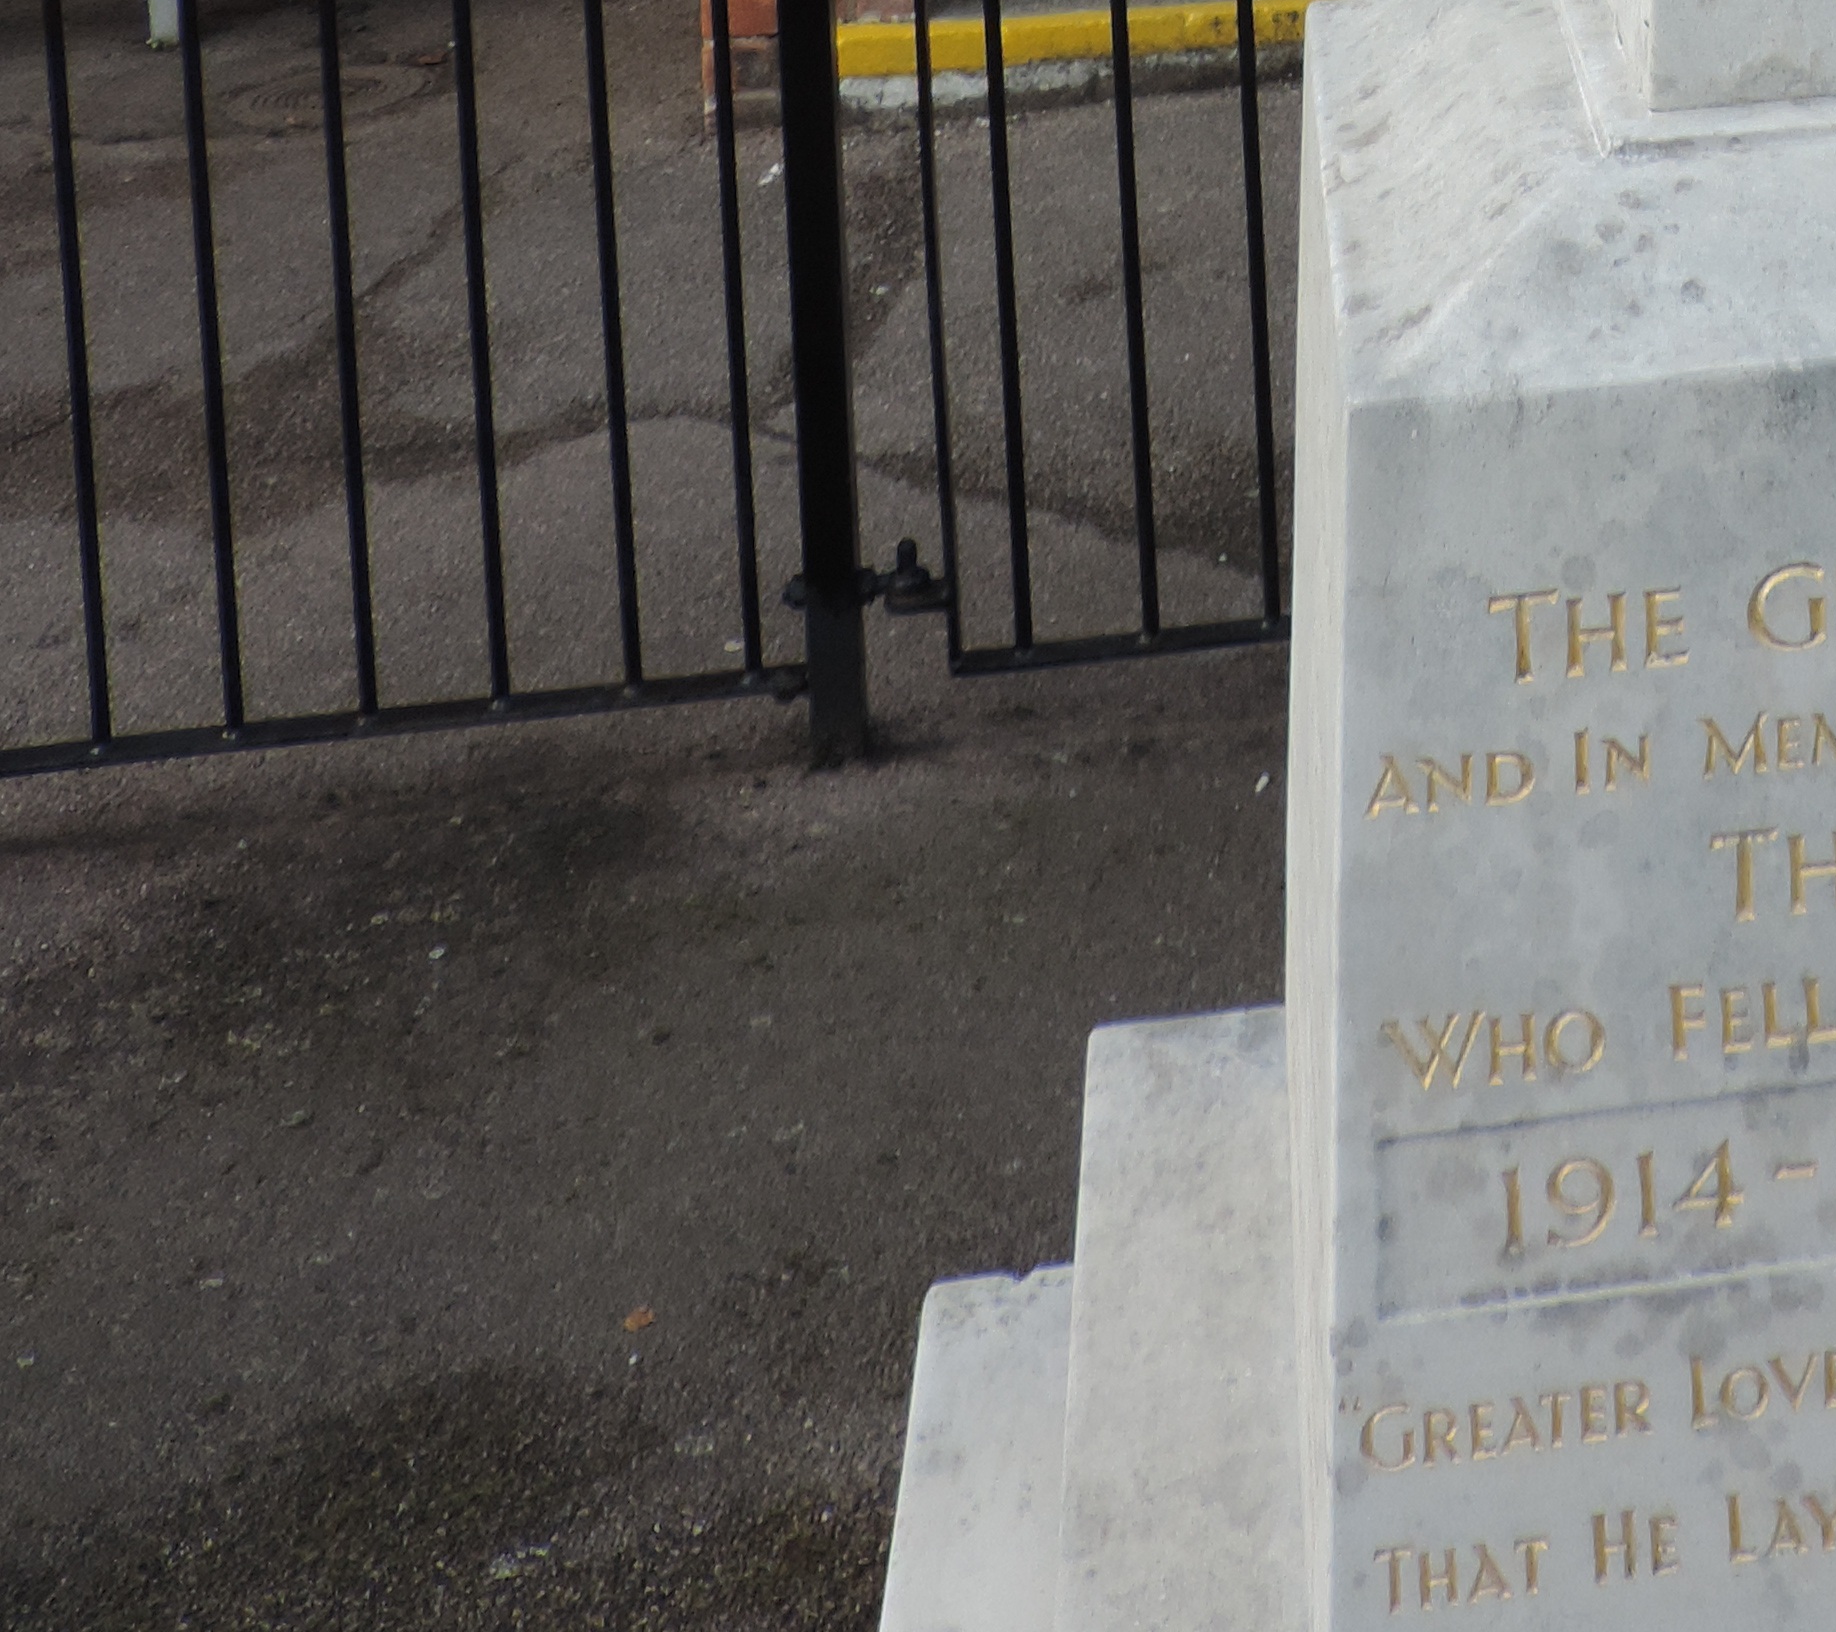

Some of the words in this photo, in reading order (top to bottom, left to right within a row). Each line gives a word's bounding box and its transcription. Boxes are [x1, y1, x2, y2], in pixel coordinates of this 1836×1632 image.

[1486, 584, 1692, 687] THE
[1361, 749, 1538, 821] AND
[1572, 727, 1652, 797] IN
[1380, 1007, 1608, 1092] WHO
[1372, 1535, 1552, 1617] THAT
[1590, 1507, 1681, 1586] HE
